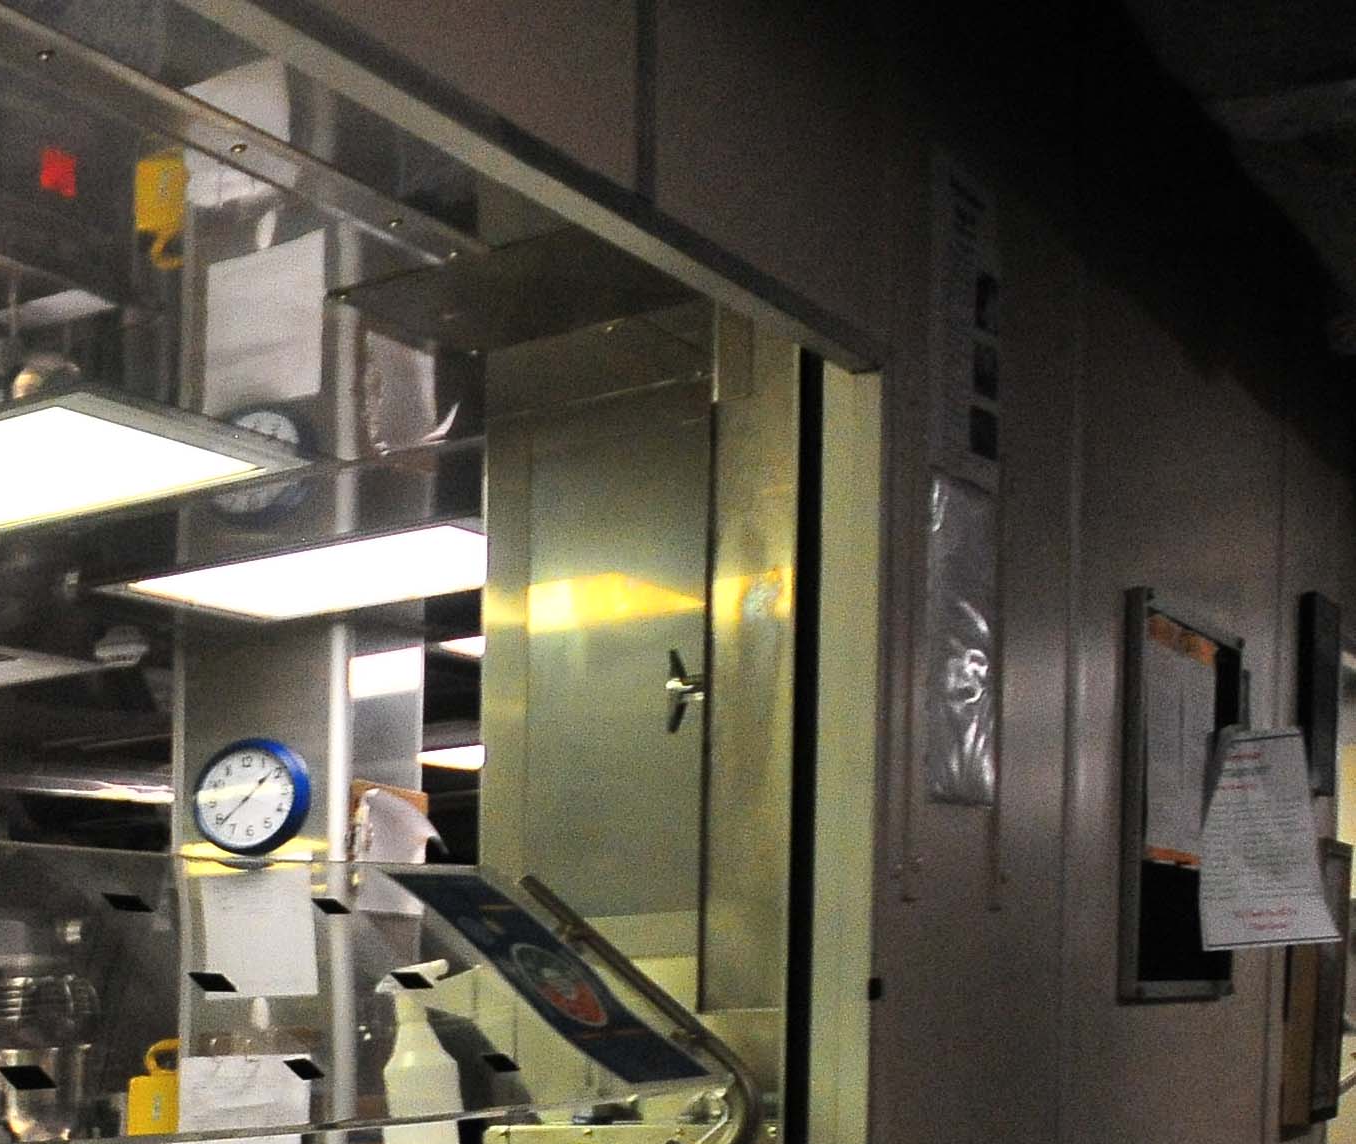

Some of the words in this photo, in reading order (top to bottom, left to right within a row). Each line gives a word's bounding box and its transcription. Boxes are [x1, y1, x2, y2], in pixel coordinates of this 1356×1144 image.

[241, 755, 253, 768] 12
[274, 767, 283, 779] 2
[215, 813, 225, 825] 8
[263, 816, 273, 829] 5
[230, 823, 238, 835] 7
[246, 825, 255, 837] 6
